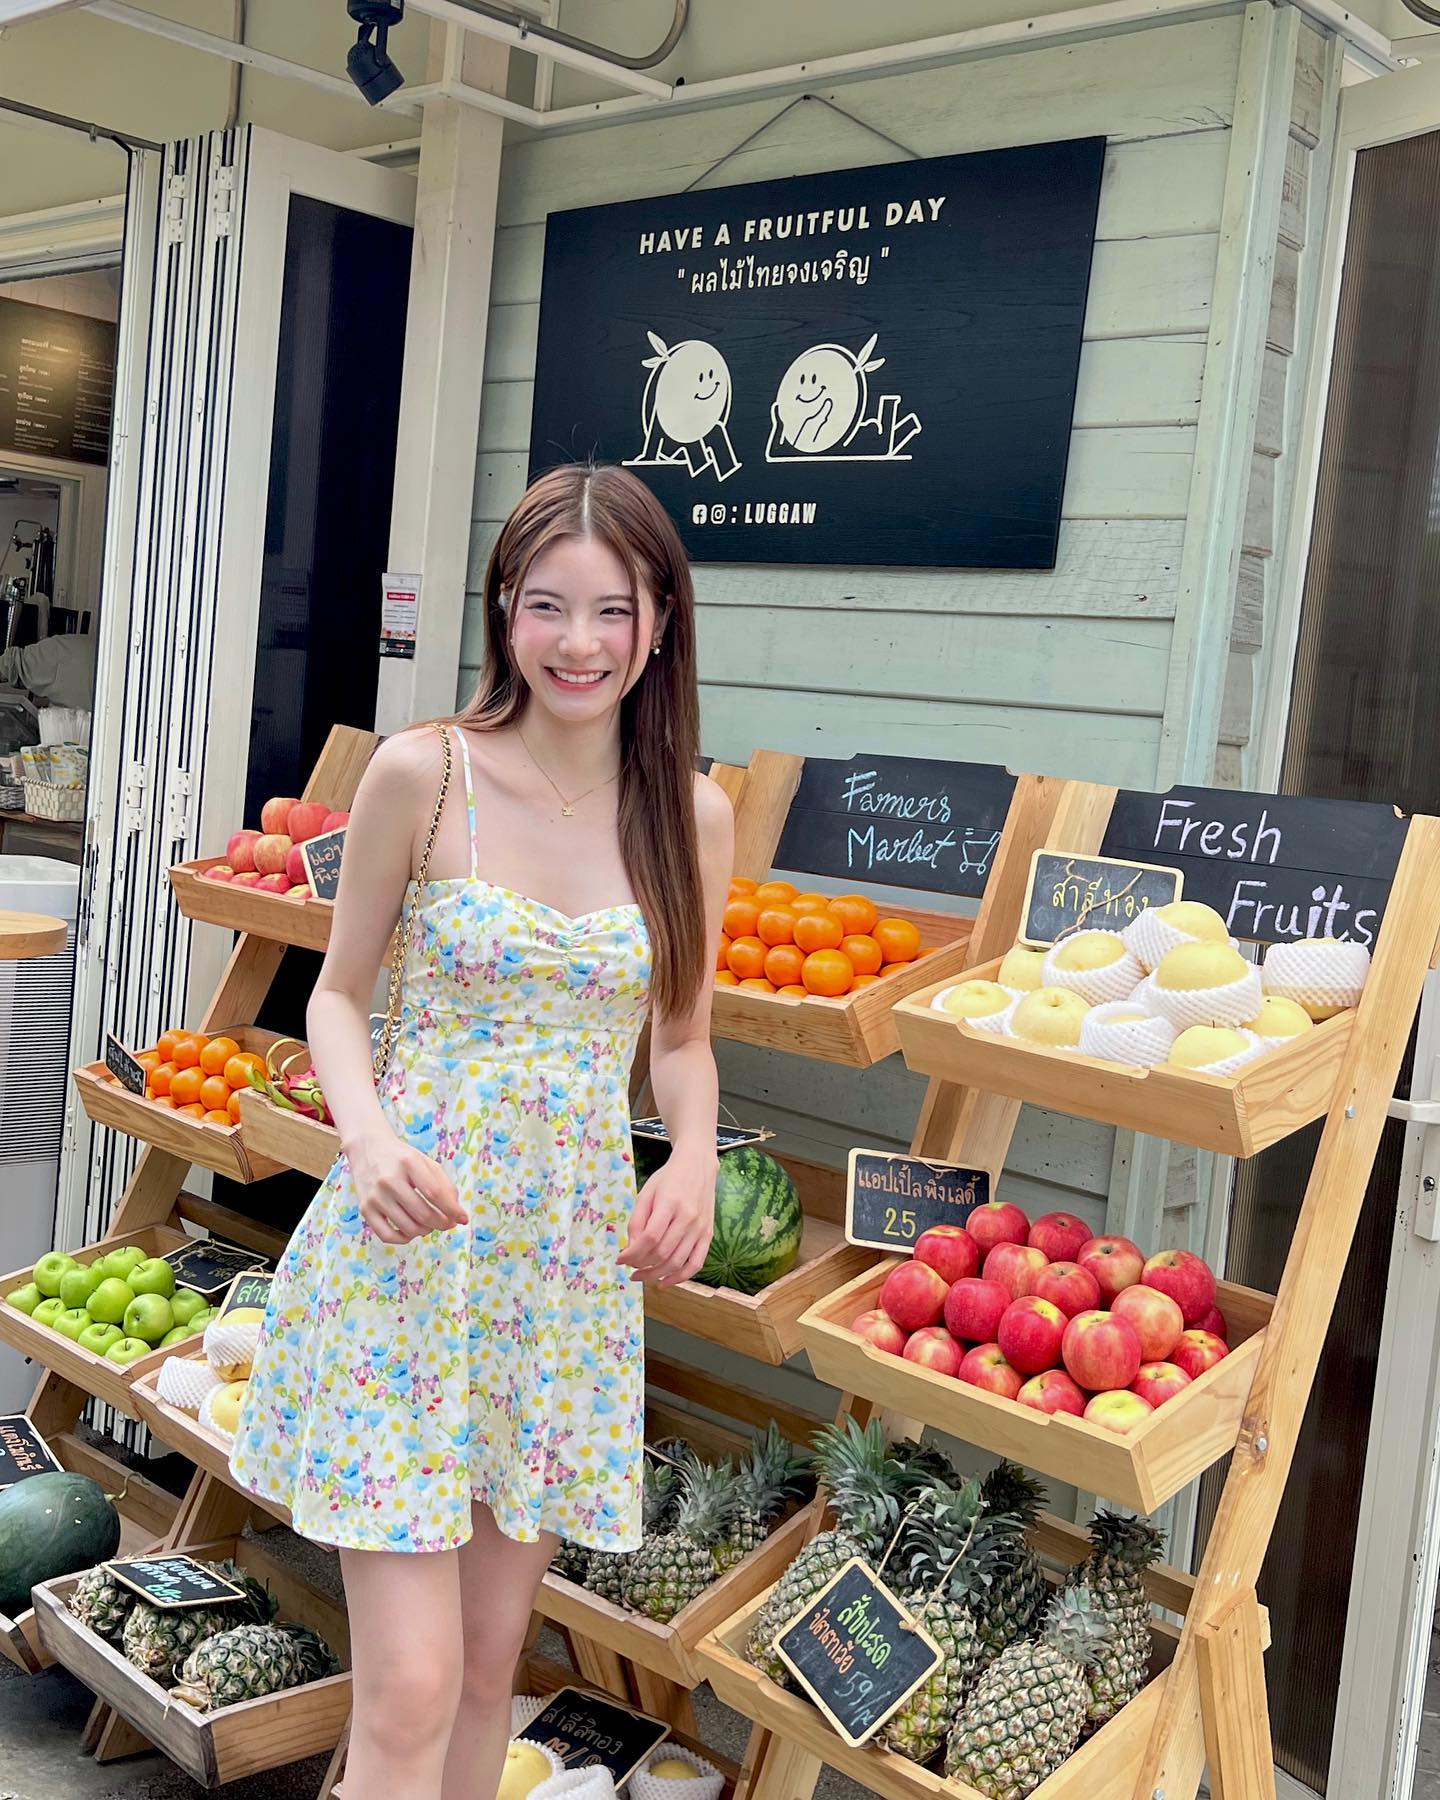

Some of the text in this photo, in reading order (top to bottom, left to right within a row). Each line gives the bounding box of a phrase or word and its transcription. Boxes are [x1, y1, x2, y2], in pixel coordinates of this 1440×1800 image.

[640, 197, 946, 255] HAVE A FRUITFUL DAY
[744, 502, 817, 524] LUGGAW
[1154, 799, 1282, 864] Fresh
[1226, 880, 1377, 946] Fruits
[883, 1207, 917, 1239] 25
[837, 1594, 892, 1670] สับปะรด
